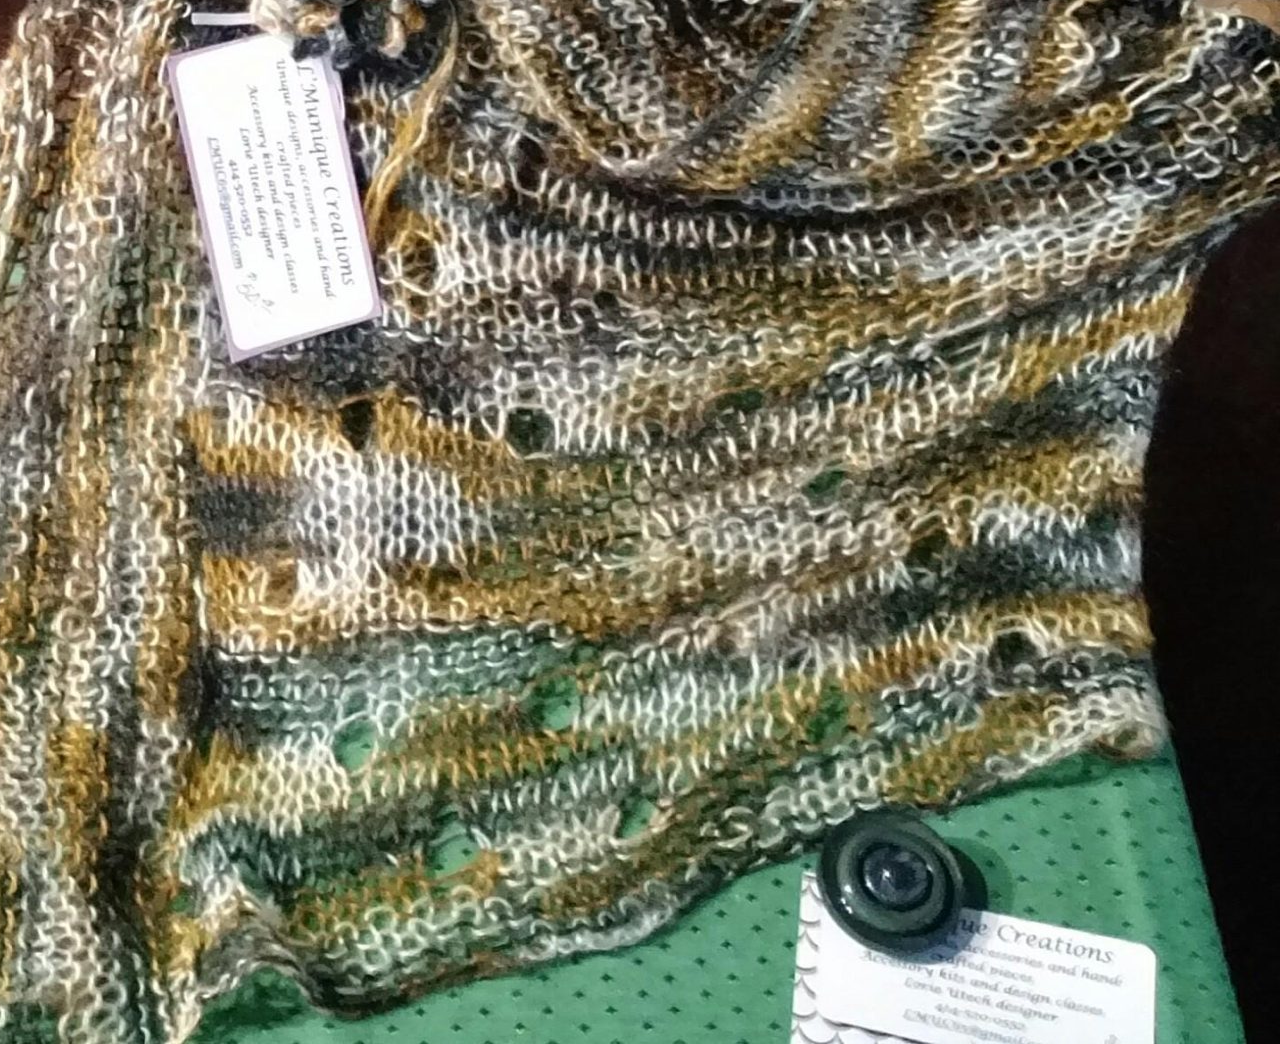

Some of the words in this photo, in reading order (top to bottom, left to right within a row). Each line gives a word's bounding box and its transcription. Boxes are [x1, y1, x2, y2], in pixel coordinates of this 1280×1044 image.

[247, 85, 267, 148] Accessory
[238, 127, 253, 160] Lorie
[261, 152, 273, 175] kits
[275, 58, 292, 106] Unique
[297, 163, 319, 232] accessories
[313, 236, 328, 261] and
[275, 140, 295, 187] crafted
[247, 163, 265, 203] Utech
[267, 178, 283, 204] and
[295, 64, 332, 178] L'Munique
[322, 185, 354, 285] Creations
[273, 207, 289, 249] design
[283, 191, 301, 229] pieces
[255, 206, 275, 259] designer
[282, 252, 298, 294] classes
[996, 924, 1113, 963] Creations
[863, 948, 934, 978] Accessory
[938, 967, 965, 983] kits
[968, 978, 1000, 993] and
[1002, 984, 1051, 1005] design
[1046, 963, 1076, 977] and
[947, 986, 992, 1007] Utech
[994, 999, 1059, 1021] designer
